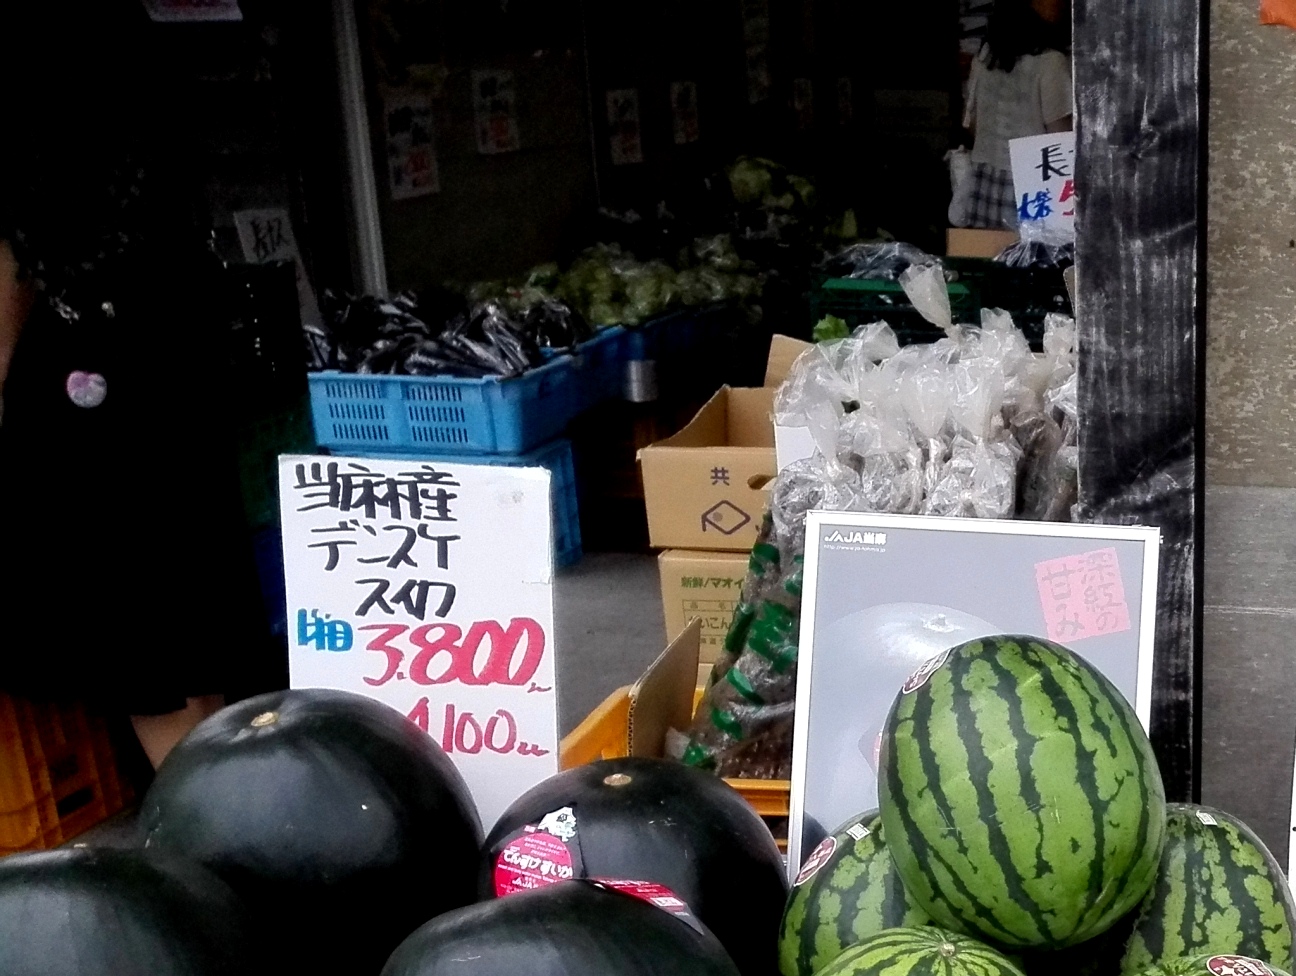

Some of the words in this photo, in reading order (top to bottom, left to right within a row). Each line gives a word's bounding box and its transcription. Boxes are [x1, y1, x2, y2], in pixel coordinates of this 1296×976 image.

[1035, 143, 1074, 182] 長
[293, 461, 461, 522] 当麻産
[710, 466, 730, 486] 共
[307, 518, 461, 572] デンスケ
[354, 578, 456, 621] スイカ
